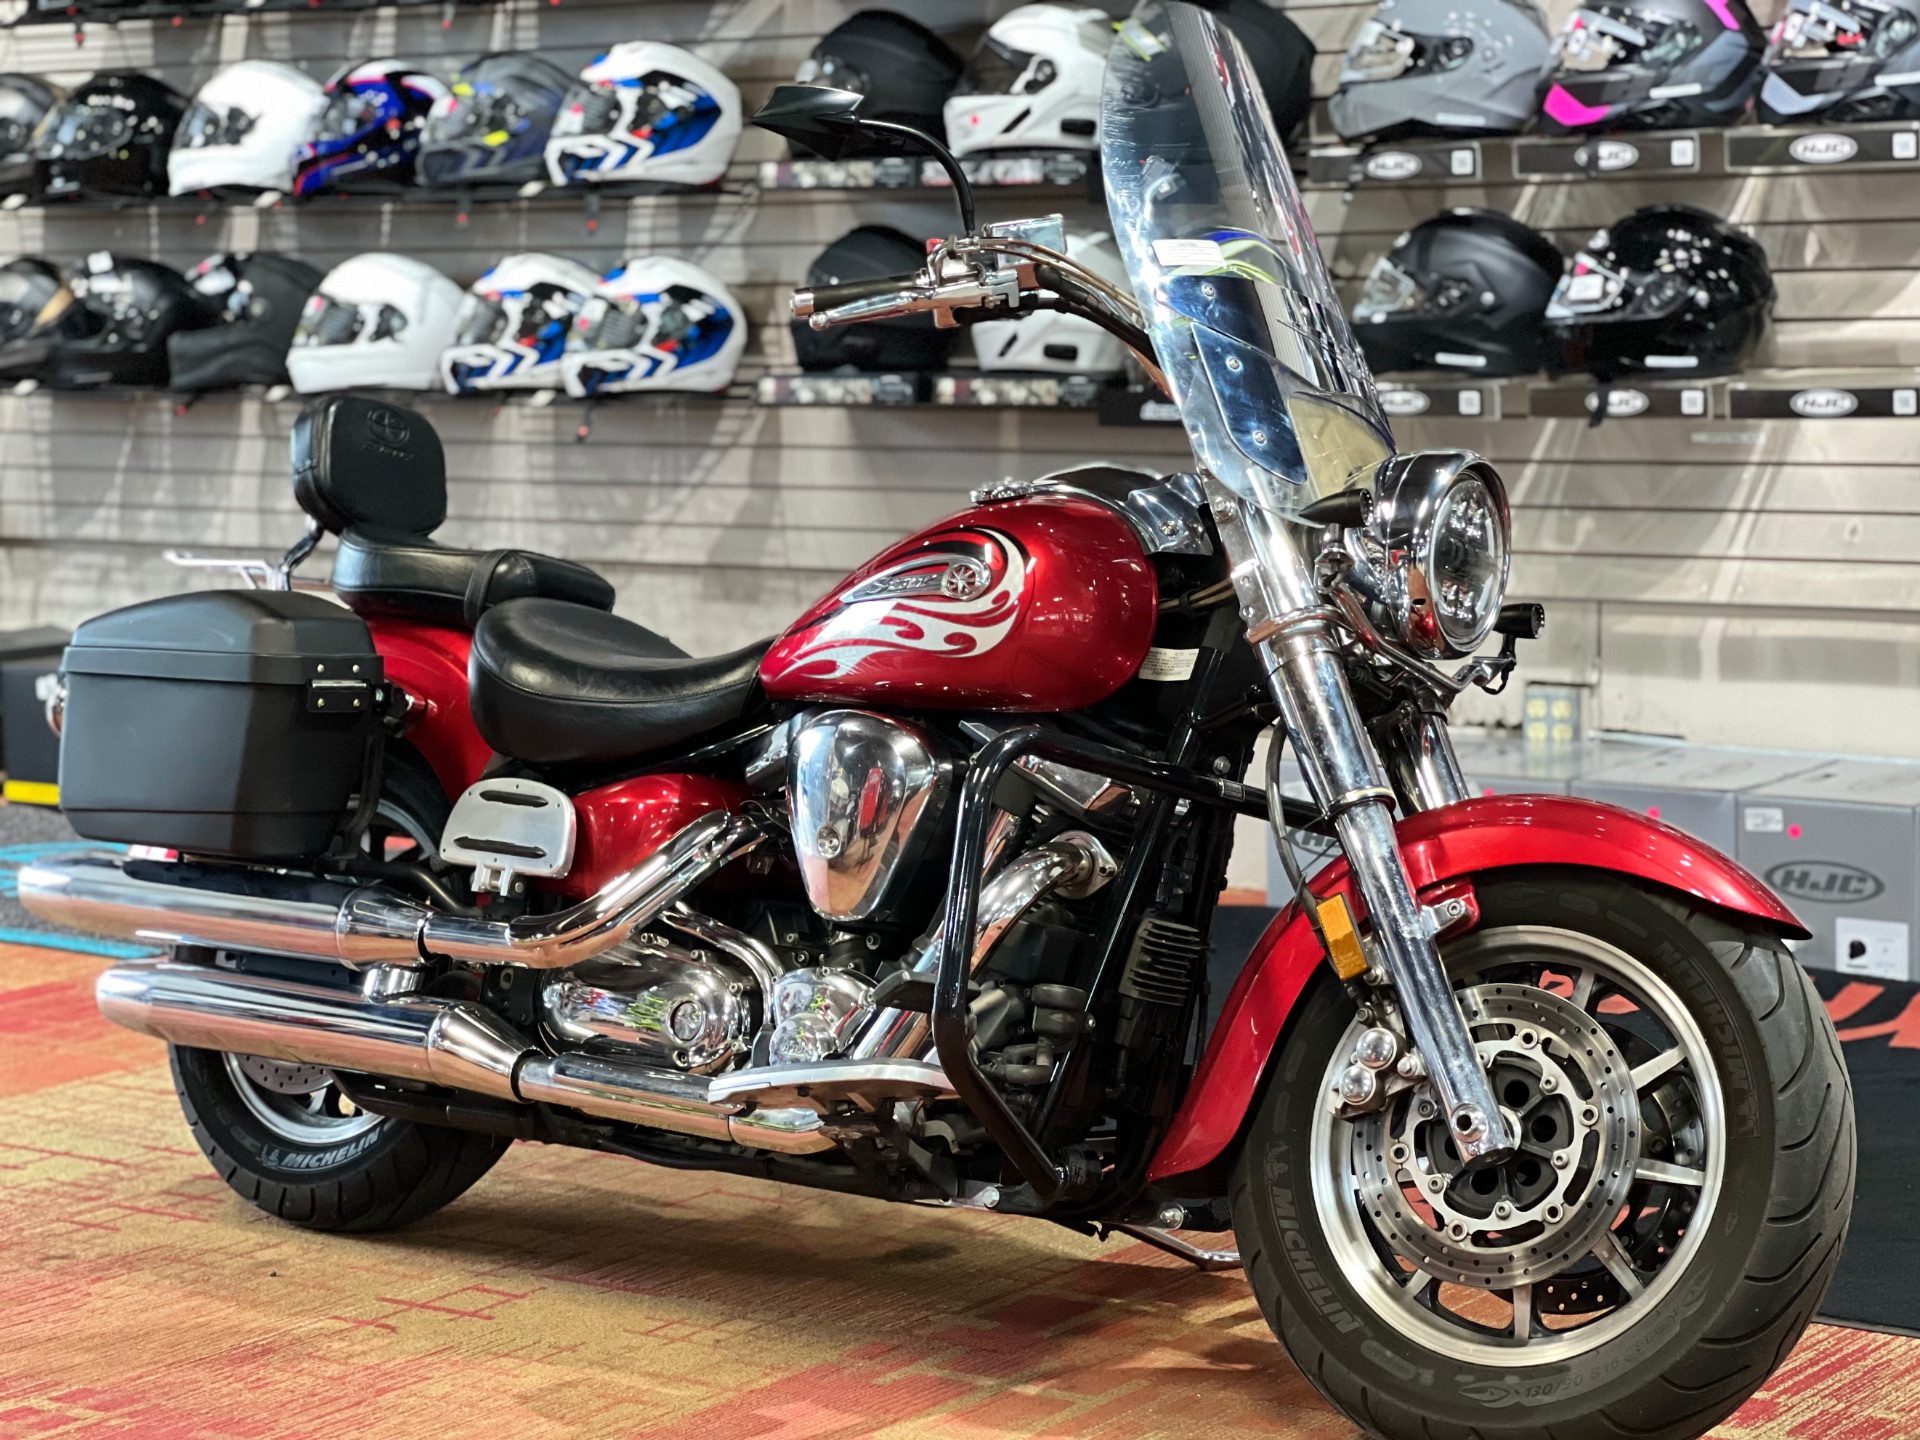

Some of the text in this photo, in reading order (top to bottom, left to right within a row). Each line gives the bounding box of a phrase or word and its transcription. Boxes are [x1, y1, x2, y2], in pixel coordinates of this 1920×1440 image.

[1781, 868, 1868, 895] HJC
[1655, 942, 1750, 1089] MICHELIN
[281, 1126, 380, 1168] MICHELIN
[1272, 1186, 1360, 1334] MICHELIN
[1524, 1374, 1583, 1398] 130/90
